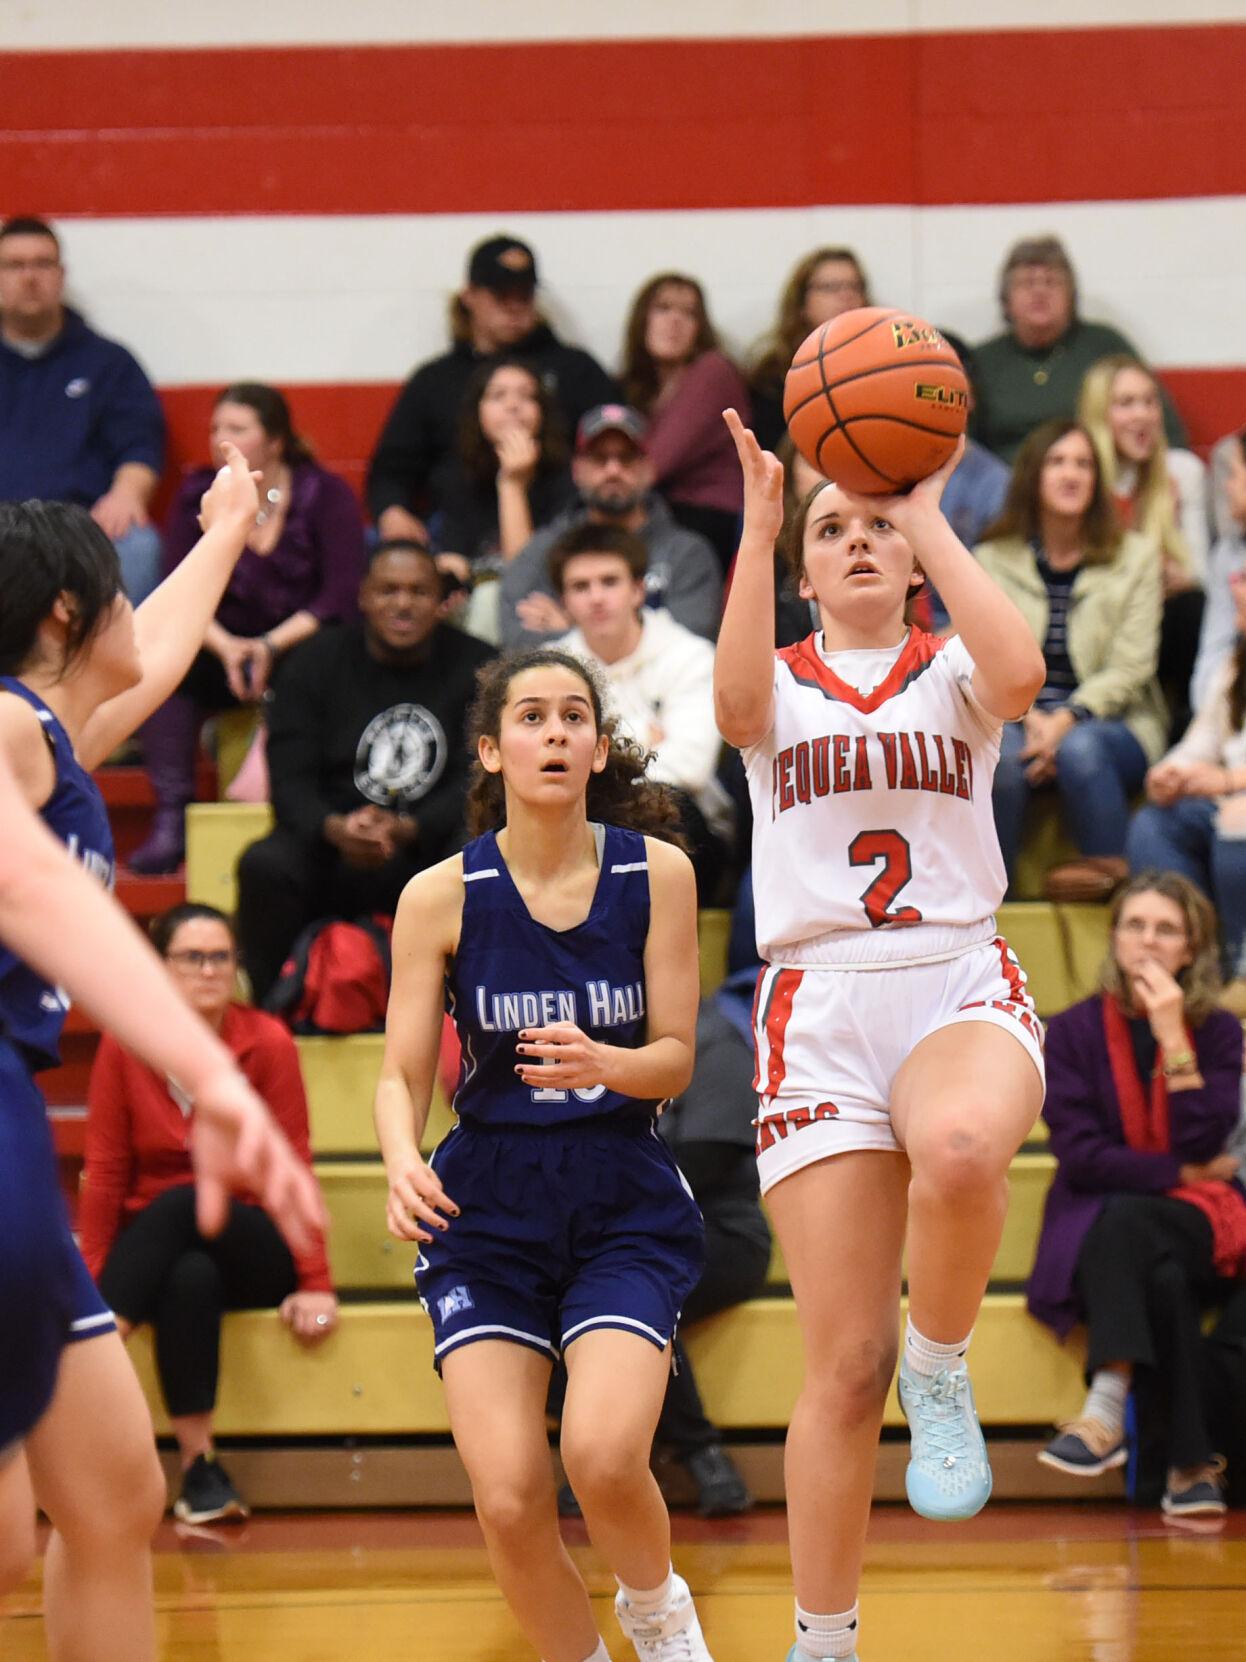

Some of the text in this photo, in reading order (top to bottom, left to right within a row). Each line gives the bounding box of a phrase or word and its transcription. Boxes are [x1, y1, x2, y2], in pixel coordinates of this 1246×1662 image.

[848, 829, 922, 928] 2
[475, 979, 645, 1033] LINDEN HALL
